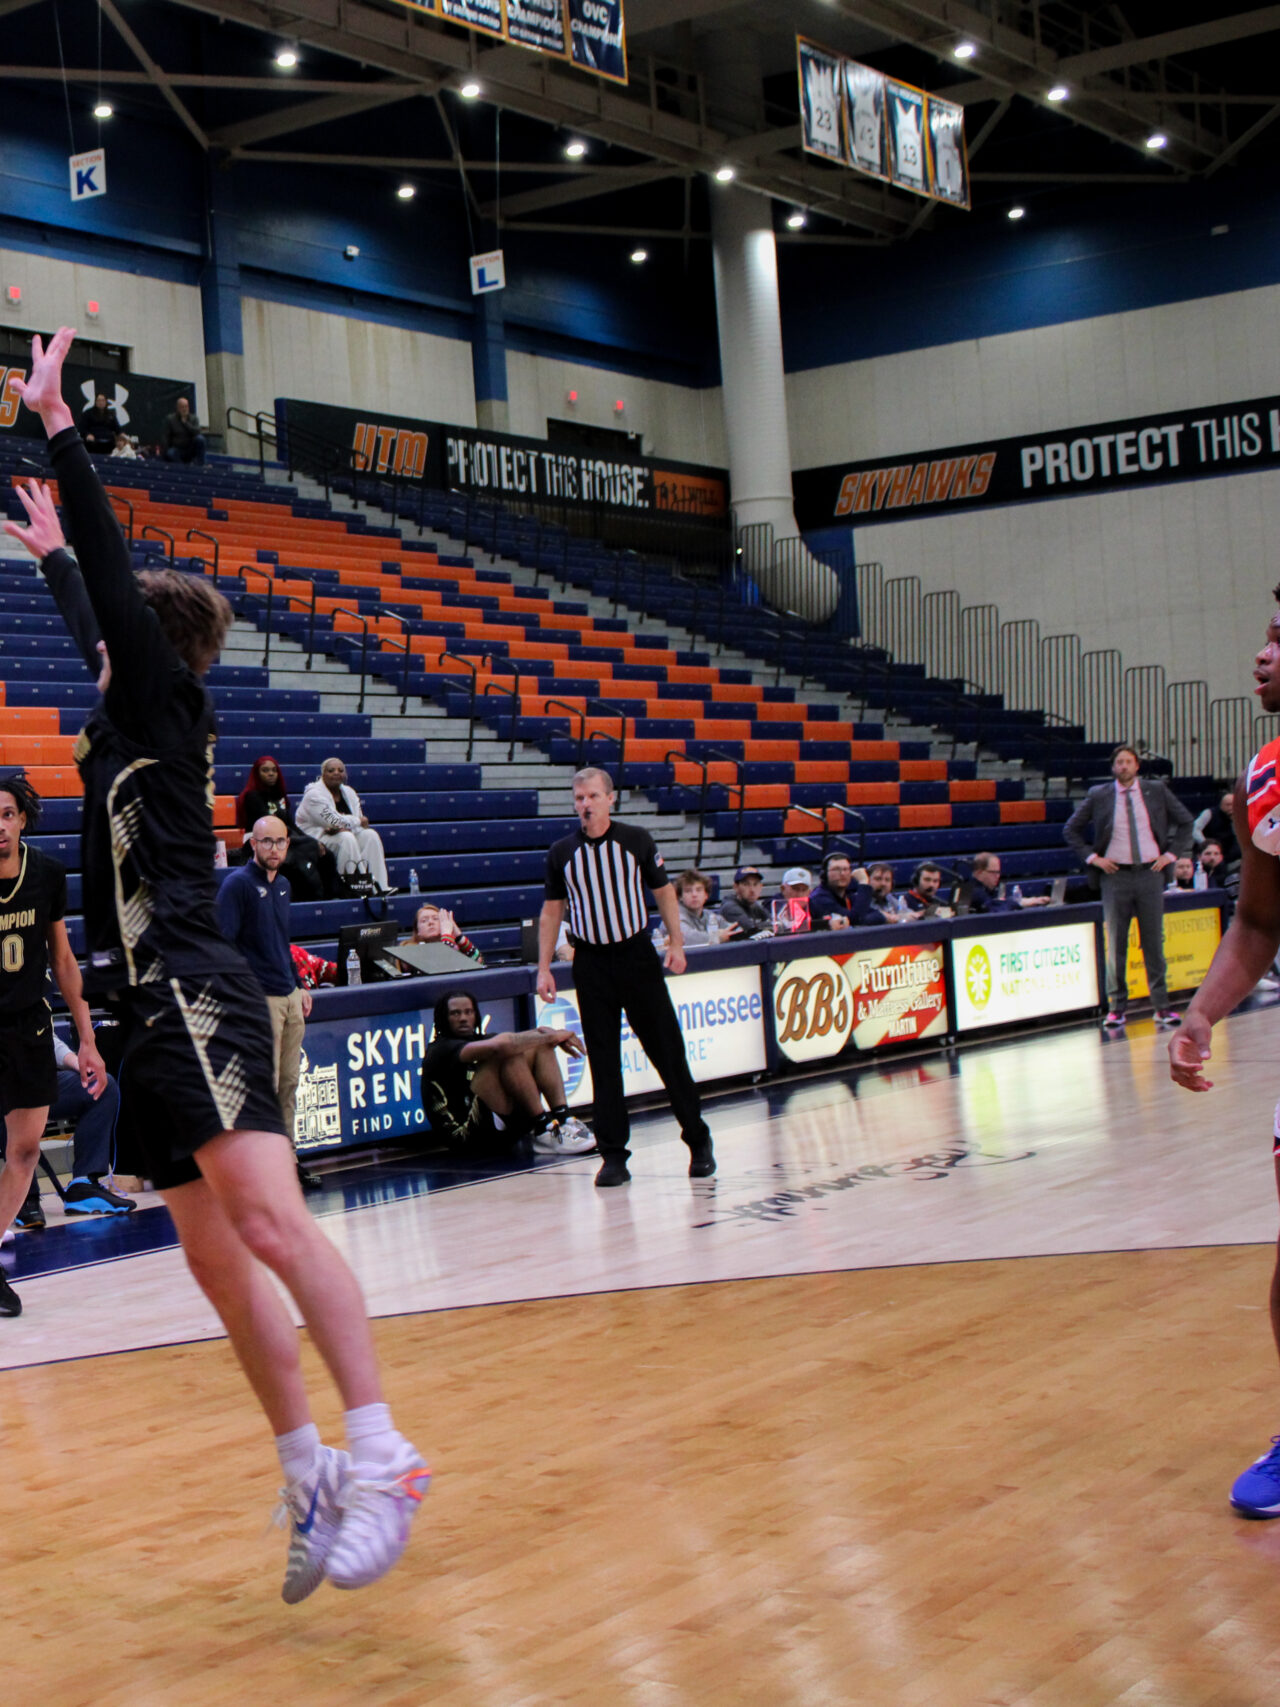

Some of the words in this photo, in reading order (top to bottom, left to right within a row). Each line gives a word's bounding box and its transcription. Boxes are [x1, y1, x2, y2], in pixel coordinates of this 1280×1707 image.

[816, 107, 833, 132] 23
[76, 166, 99, 196] K
[477, 266, 499, 290] L
[351, 423, 429, 479] UTM
[1021, 423, 1184, 489] PROTECT
[1192, 412, 1262, 463] THIS
[541, 452, 579, 500] THIS
[833, 452, 997, 516] SKYHAWKS
[858, 955, 941, 995] Furniture
[1000, 950, 1029, 974] FIRST
[1033, 943, 1081, 968] CITIZENS
[677, 992, 762, 1031] nnessee
[776, 972, 848, 1043] BB's
[912, 991, 943, 1012] Gallery
[352, 1114, 392, 1135] FIND
[402, 1108, 424, 1126] YO
